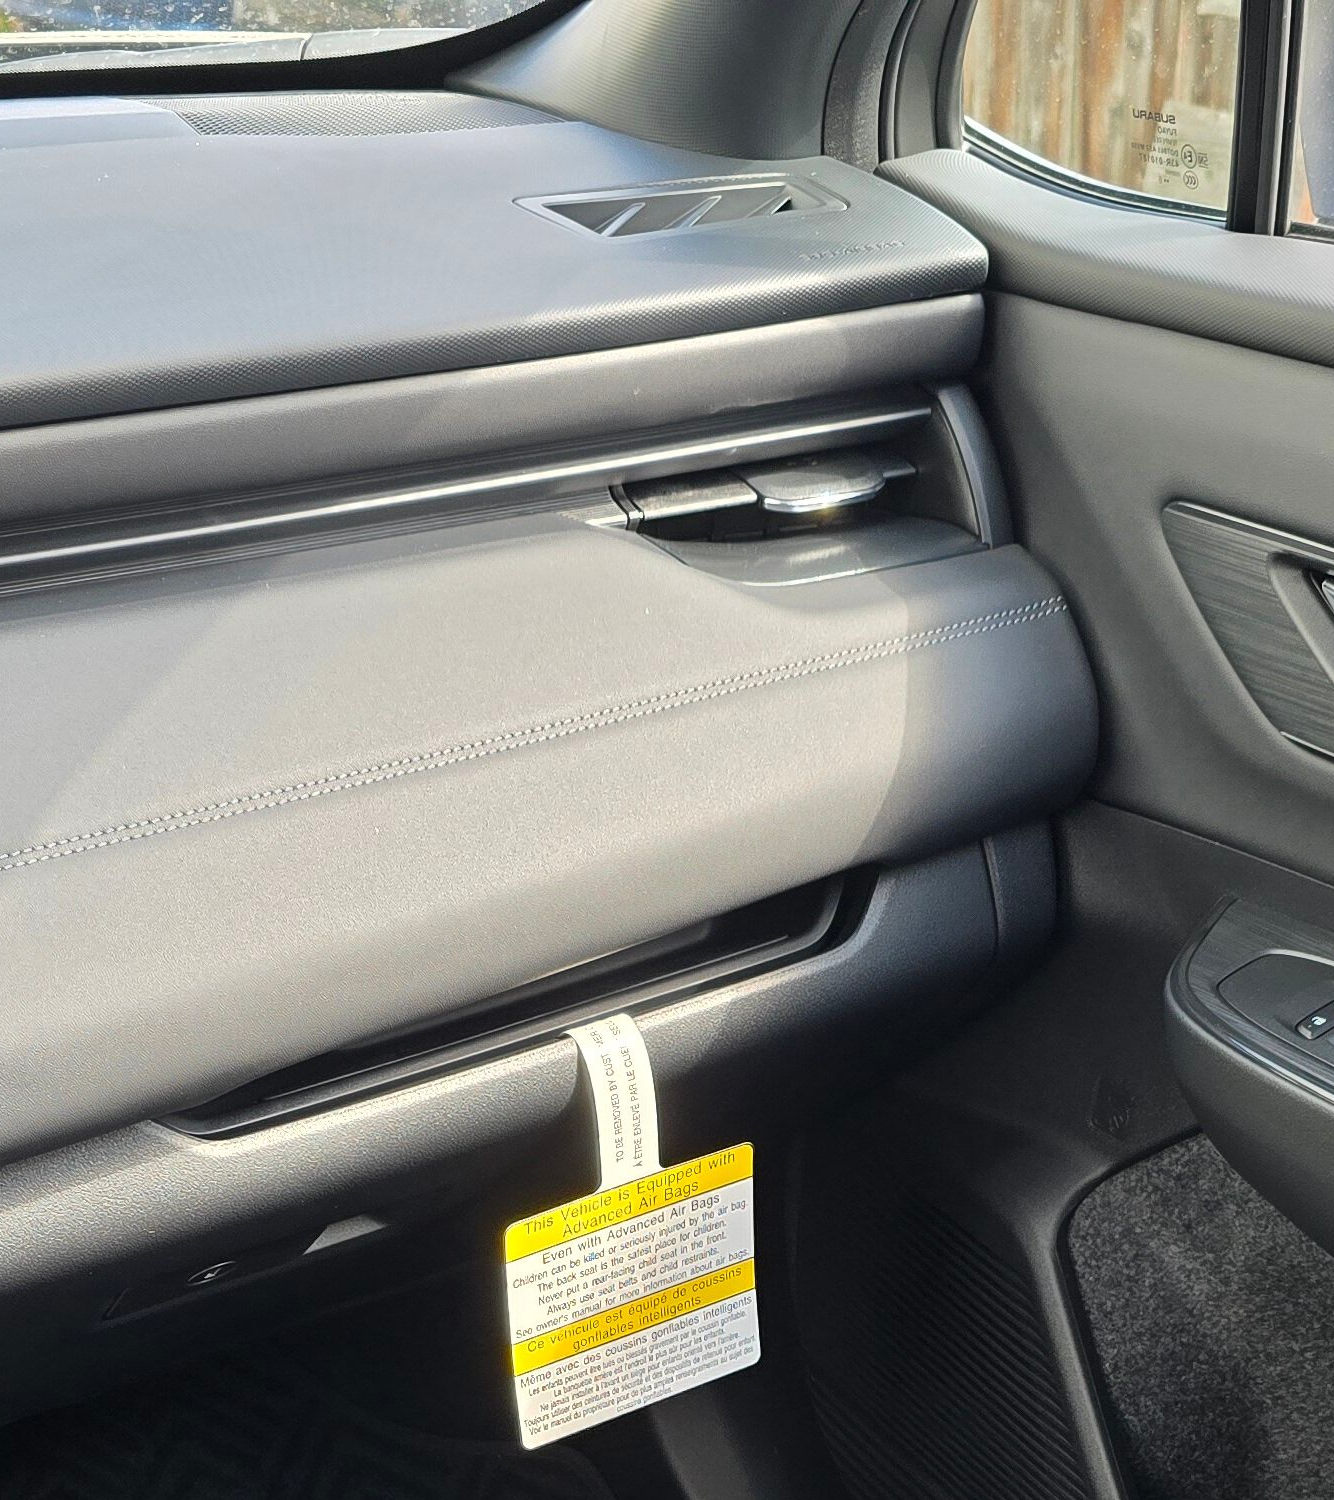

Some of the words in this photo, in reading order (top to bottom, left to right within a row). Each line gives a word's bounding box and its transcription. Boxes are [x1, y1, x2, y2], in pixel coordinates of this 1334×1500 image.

[523, 1216, 553, 1234] This
[560, 1195, 611, 1220] Vehicle
[618, 1188, 629, 1201] is
[636, 1161, 701, 1194] Equipped
[708, 1151, 735, 1169] with
[562, 1201, 632, 1237] Advanced
[638, 1194, 657, 1210] Air
[663, 1181, 698, 1201] Bags
[542, 1246, 572, 1264] Even
[577, 1235, 601, 1251] with
[606, 1211, 664, 1241] Advanced
[669, 1205, 686, 1219] Air
[690, 1194, 719, 1211] Bags
